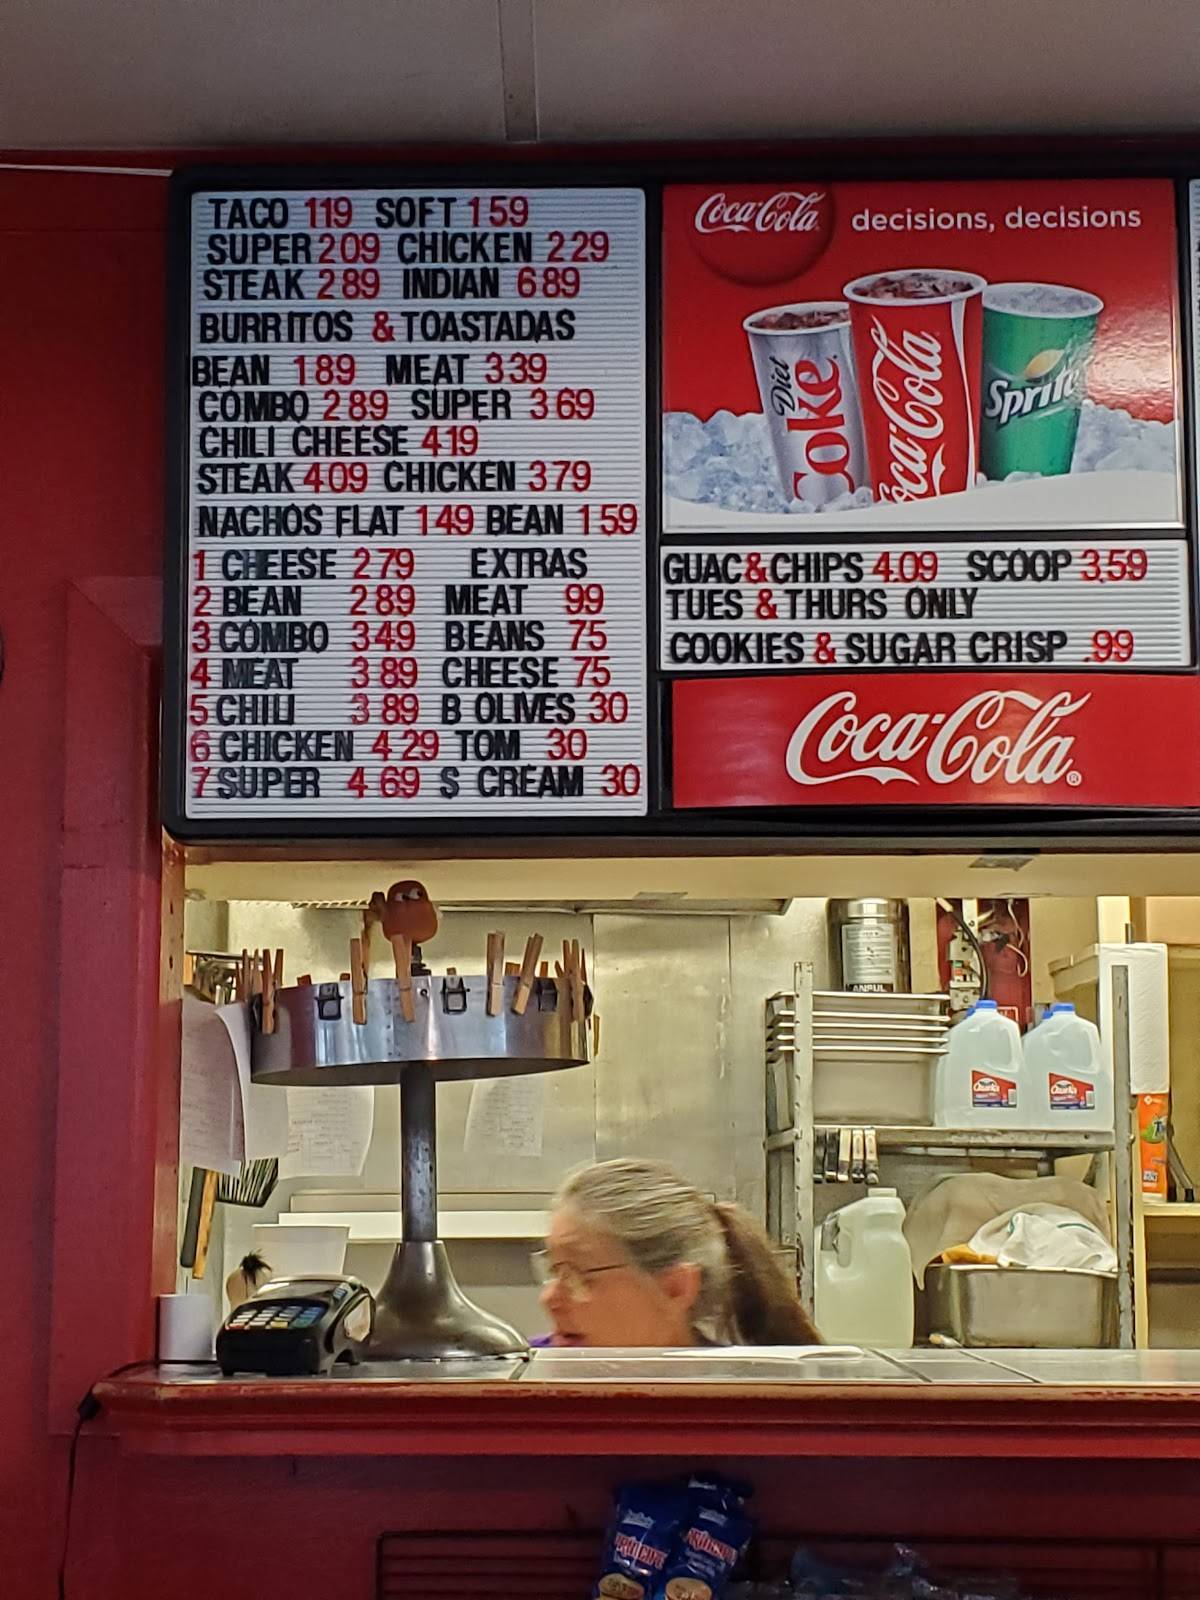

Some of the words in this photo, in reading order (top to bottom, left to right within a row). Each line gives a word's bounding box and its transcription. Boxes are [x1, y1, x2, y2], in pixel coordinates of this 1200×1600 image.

[208, 197, 289, 229] TACO
[304, 196, 352, 228] 119
[375, 196, 457, 229] SOFT
[695, 192, 826, 233] Coca-Cola
[852, 207, 995, 233] decisions,
[1005, 206, 1141, 230] decisions
[207, 233, 311, 264] SUPER
[318, 233, 380, 264] 209
[398, 232, 532, 264] CHICKEN
[547, 231, 609, 263] 229
[204, 269, 304, 300] STEAK
[317, 268, 379, 300] 289
[403, 267, 499, 299] INDIAN
[517, 266, 580, 298] 689
[200, 311, 352, 343] BURRITOS
[400, 309, 575, 342] TOASTADAS
[192, 354, 269, 387] BEAN
[293, 353, 355, 386] 189
[386, 353, 469, 385] MEAT
[485, 352, 546, 384] 339
[769, 356, 796, 416] Diet
[199, 391, 309, 422] COMBO
[323, 390, 388, 422] 289
[411, 389, 511, 421] SUPER
[529, 388, 594, 420] 369
[985, 364, 1080, 425] Sprite
[199, 426, 274, 458] CHILI
[292, 425, 408, 457] CHEESE
[421, 425, 478, 456] 419
[198, 463, 295, 495] STEAK
[304, 462, 367, 493] 409
[384, 461, 515, 493] CHICKEN
[528, 461, 591, 493] 379
[200, 505, 322, 538] NACHOS
[336, 505, 403, 537] FLAT
[416, 504, 473, 535] 149
[486, 504, 563, 536] BEAN
[192, 548, 205, 580] 1
[222, 548, 336, 581] CHEESE
[353, 547, 414, 580] 279
[471, 547, 587, 579] EXTRAS
[872, 551, 937, 582] 4.09
[967, 550, 1072, 582] SCOOP
[1080, 549, 1147, 584] 3.59
[194, 586, 211, 616] 2
[222, 585, 301, 617] BEAN
[350, 584, 415, 616] 289
[445, 584, 528, 616] MEAT
[565, 583, 604, 615] 99
[667, 589, 743, 621] TUES
[906, 586, 978, 620] ONLY
[193, 622, 211, 653] 3
[219, 620, 328, 653] COMBO
[351, 620, 415, 652] 349
[445, 620, 544, 652] BEANS
[568, 619, 607, 651] 75
[670, 633, 804, 664] COOKIES
[814, 632, 836, 663] &
[846, 632, 956, 665] SUGAR
[969, 632, 1067, 663] CRISP
[190, 659, 211, 689] 4
[222, 657, 298, 690] MEAT
[351, 656, 418, 689] 389
[442, 656, 558, 688] CHEESE
[574, 656, 610, 687] 75
[190, 695, 208, 725] 5
[216, 694, 295, 726] CHILI
[351, 693, 418, 725] 389
[442, 692, 461, 725] B
[475, 692, 575, 724] OLIVES
[589, 691, 628, 724] 30
[190, 731, 210, 763] 6
[219, 730, 353, 762] CHICKEN
[372, 729, 439, 761] 429
[455, 729, 520, 761] TOM
[547, 728, 587, 761] 30
[786, 691, 1091, 786] Coca-Cola
[192, 767, 210, 798] 7
[217, 767, 320, 799] SUPER
[347, 766, 419, 799] 469
[440, 766, 459, 798] S
[477, 765, 583, 797] CREAM
[602, 764, 640, 796] 30
